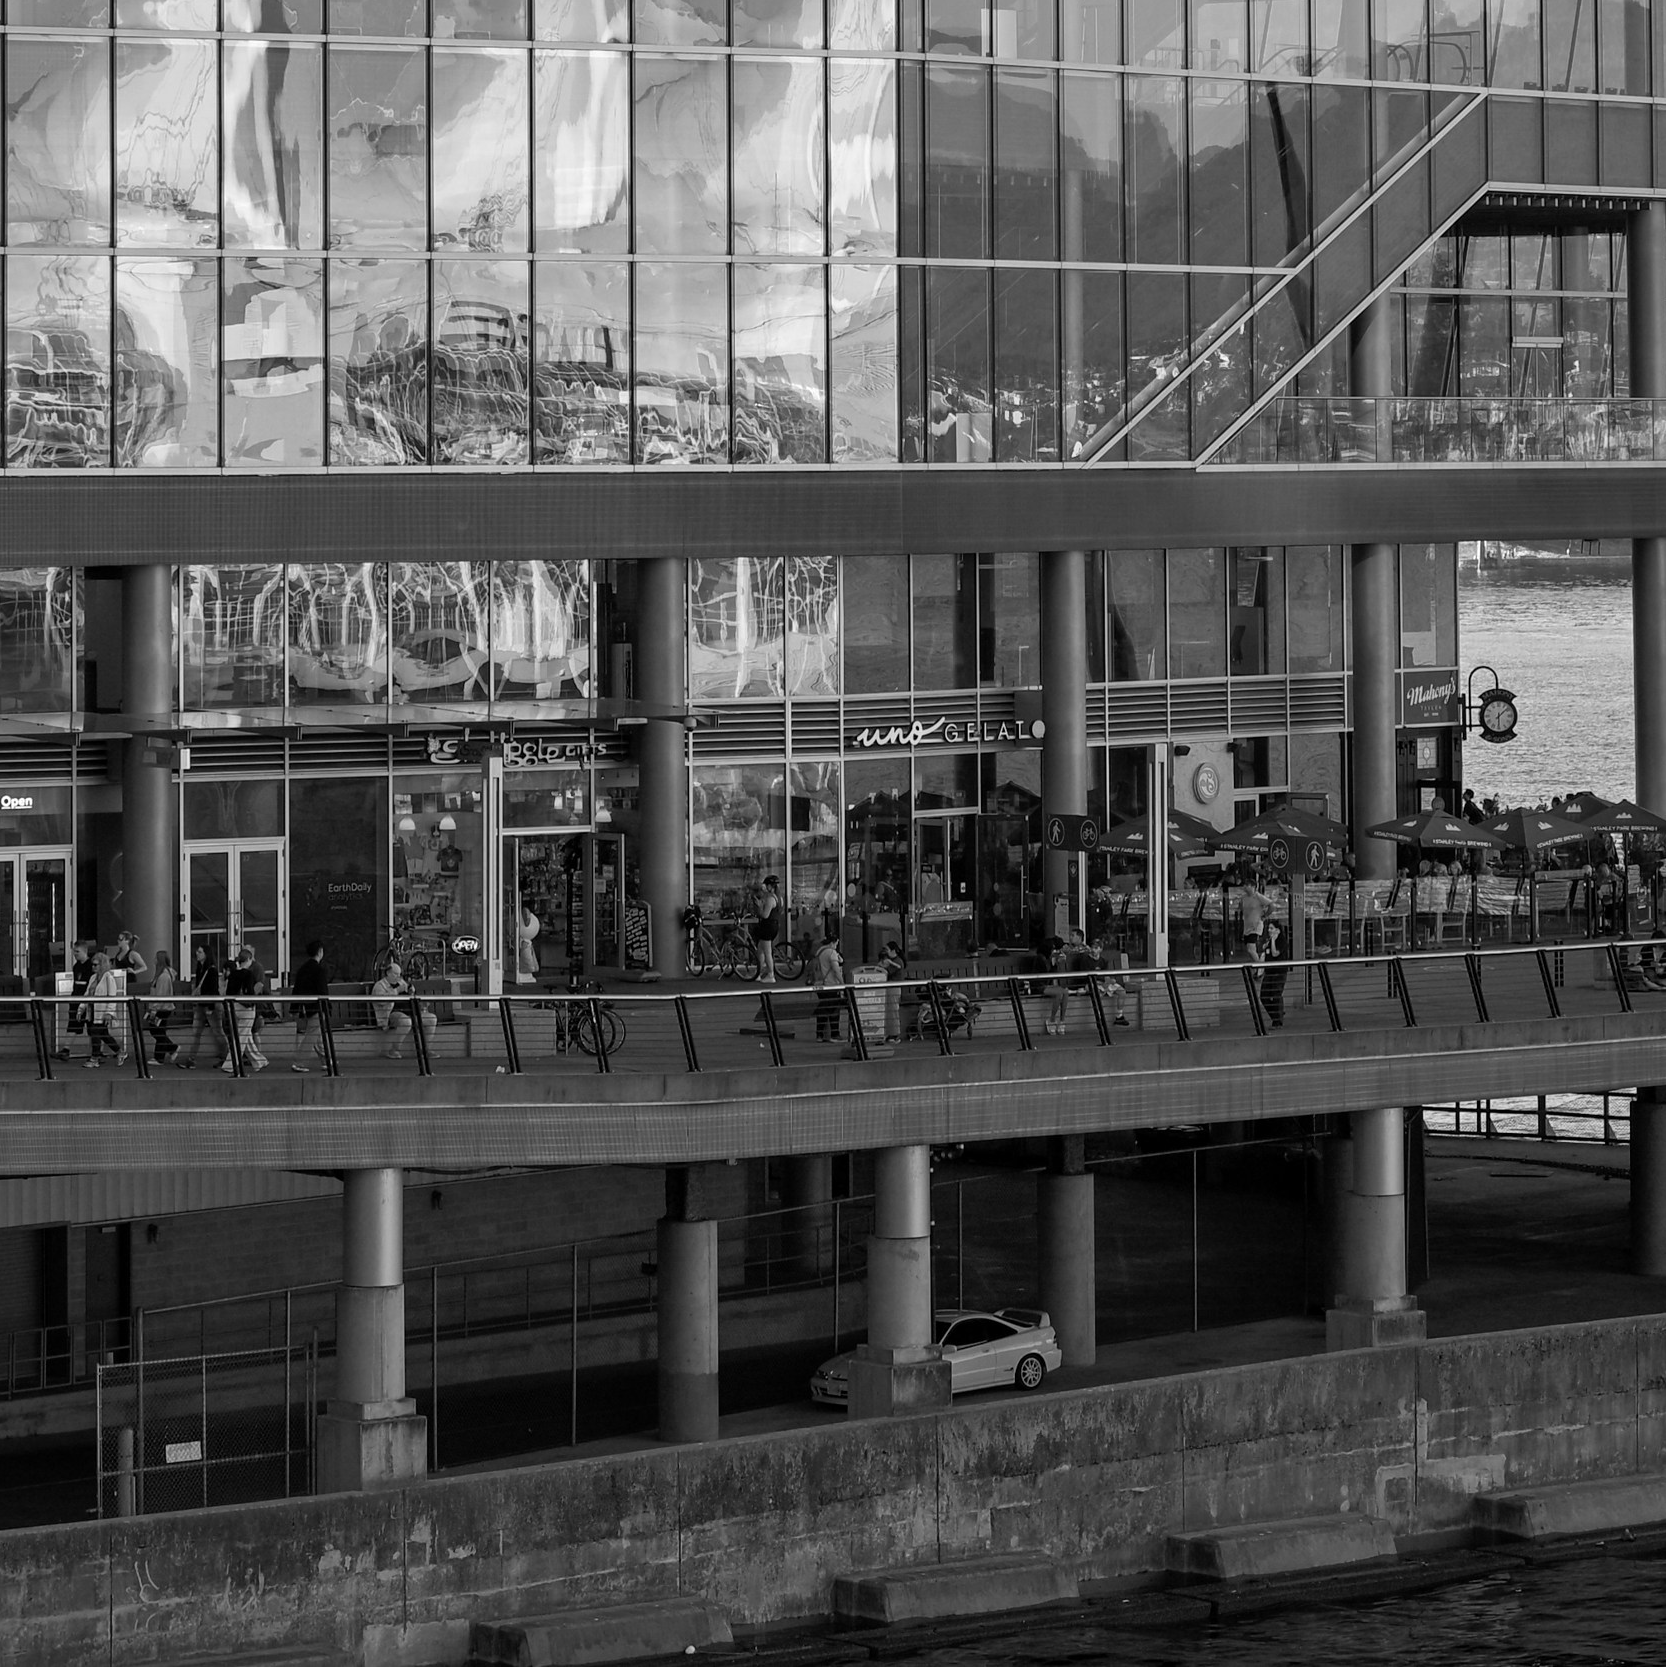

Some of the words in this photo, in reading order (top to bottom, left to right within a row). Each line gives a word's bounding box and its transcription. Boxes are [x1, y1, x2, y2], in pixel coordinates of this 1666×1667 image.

[1406, 676, 1456, 706] Mahony's
[857, 716, 945, 746] uno
[944, 720, 1046, 743] GELATO
[565, 743, 607, 756] GIFTS
[1, 795, 33, 810] Open
[328, 882, 372, 893] EarthDaily
[453, 939, 478, 952] OPEN
